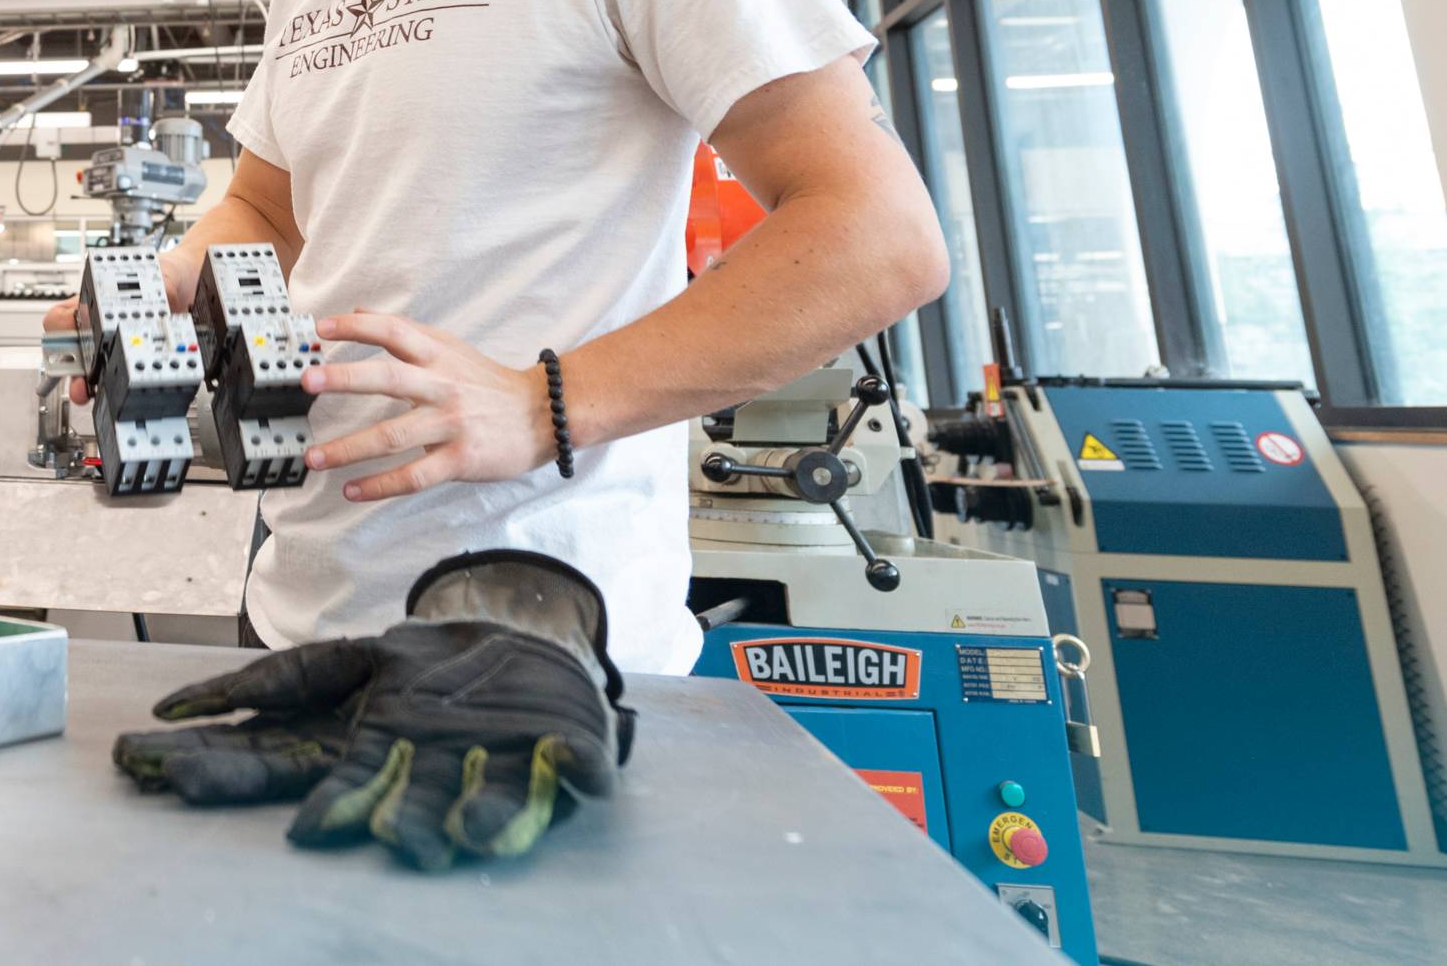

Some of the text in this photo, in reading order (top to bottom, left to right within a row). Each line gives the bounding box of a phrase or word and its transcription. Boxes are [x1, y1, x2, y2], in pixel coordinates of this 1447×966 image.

[279, 0, 346, 47] TEXAS
[289, 17, 434, 78] ENGINEERING
[744, 645, 906, 686] BAILEIGH
[774, 686, 884, 698] INDUSTRIAL
[992, 815, 1033, 843] EMERGEN
